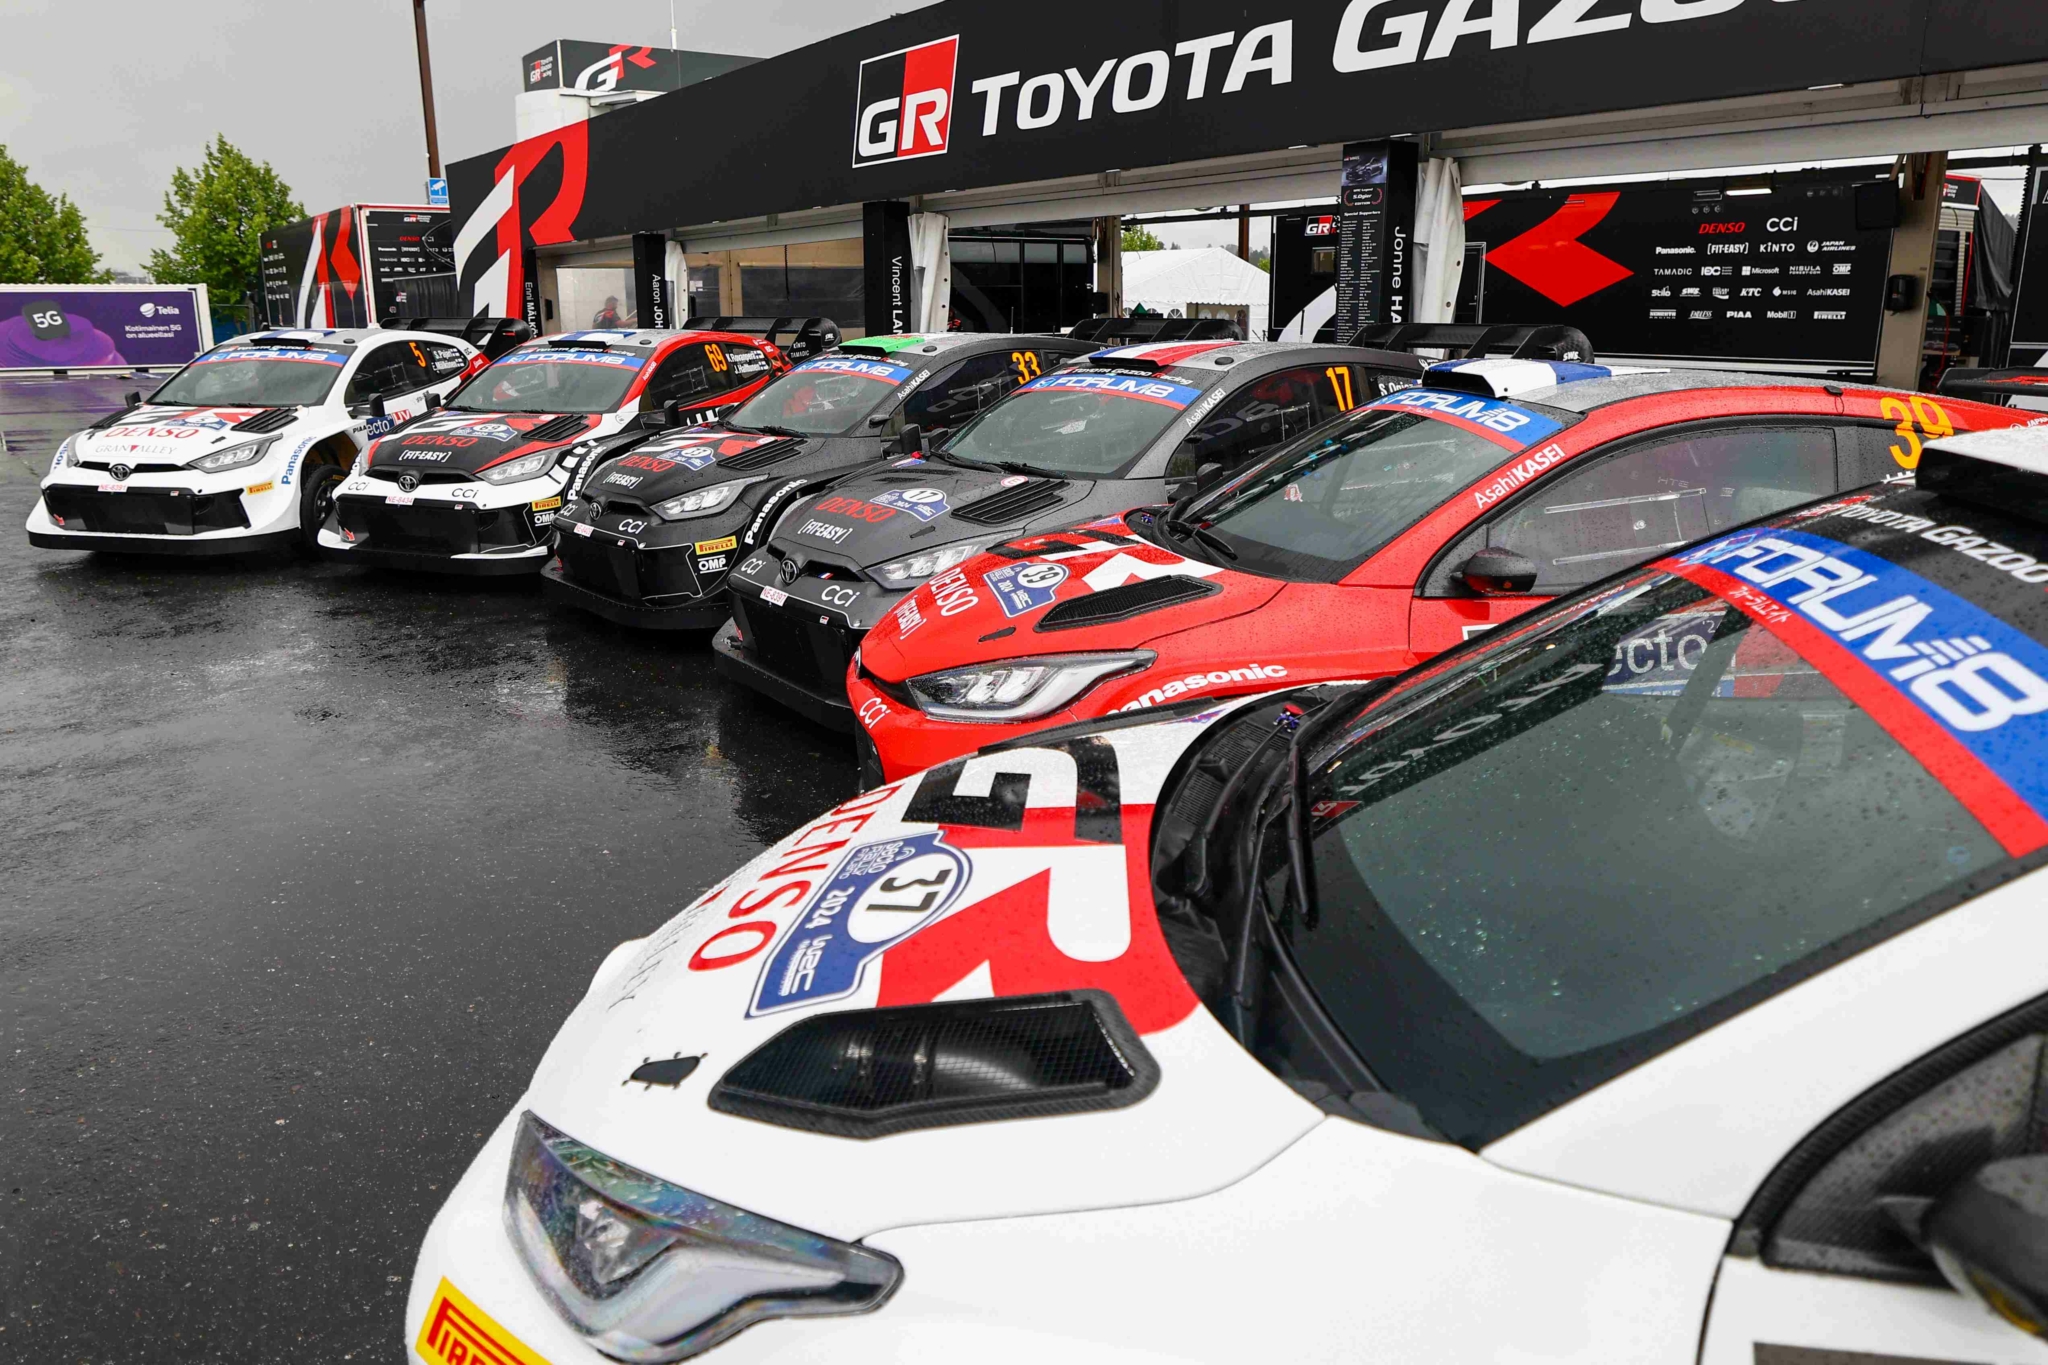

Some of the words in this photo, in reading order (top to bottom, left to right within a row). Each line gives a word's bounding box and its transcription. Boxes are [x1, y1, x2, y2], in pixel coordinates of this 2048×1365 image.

[858, 87, 948, 158] GR
[971, 19, 1293, 137] TOYOTA
[1306, 223, 1330, 234] GR
[1698, 222, 1746, 234] DENSO
[1766, 216, 1798, 232] CCi
[1391, 226, 1406, 289] Jonne
[525, 282, 534, 300] Enni
[652, 274, 662, 304] Aaron
[892, 256, 902, 306] Vincent
[1651, 286, 1671, 296] Stilo
[1740, 288, 1762, 296] KTC
[32, 310, 62, 328] 5G
[156, 306, 180, 315] Telia
[1390, 296, 1403, 324] HA
[1814, 311, 1846, 320] PIRELLI
[408, 342, 426, 368] 5
[704, 343, 728, 373] 69
[790, 350, 810, 358] TAMADIC
[881, 356, 909, 367] Racing
[1011, 350, 1042, 385] 33
[1110, 368, 1152, 377] GAZOO
[1152, 372, 1194, 385] Racing
[897, 369, 931, 400] AsahiKASEI
[1050, 376, 1176, 398] FORUM8
[1326, 366, 1355, 412] 17
[1186, 388, 1227, 428] AsahiKASEI
[1387, 392, 1531, 432] FORUM8
[104, 426, 199, 439] DENSO
[367, 420, 390, 436] ecto
[1880, 396, 1954, 470] 39
[401, 435, 479, 448] DENSO
[281, 435, 318, 486] Panasonic
[567, 446, 607, 500] Panasonic
[618, 455, 676, 472] DENSO
[249, 482, 274, 494] PIRELLI
[348, 482, 370, 491] CCi
[1472, 444, 1566, 510] AsahiKASEI
[451, 488, 480, 499] CCi
[534, 498, 560, 510] PIRELLI
[909, 490, 939, 500] 17
[560, 503, 578, 517] CCi
[744, 478, 808, 545] Panasonic
[815, 496, 897, 524] DENSO
[618, 518, 648, 534] CCi
[699, 538, 734, 553] PIRELLI
[1922, 526, 2048, 584] GAZOO
[698, 557, 727, 570] OMP
[741, 557, 767, 576] CCi
[1022, 566, 1060, 584] 39
[820, 584, 860, 608] CCi
[928, 566, 979, 617] DENSO
[1708, 538, 2048, 732] FORUM8
[1106, 664, 1288, 716] anasonic
[859, 697, 892, 729] CCi
[687, 783, 907, 972] DENSO
[866, 868, 953, 914] 37
[804, 886, 856, 930] 2024
